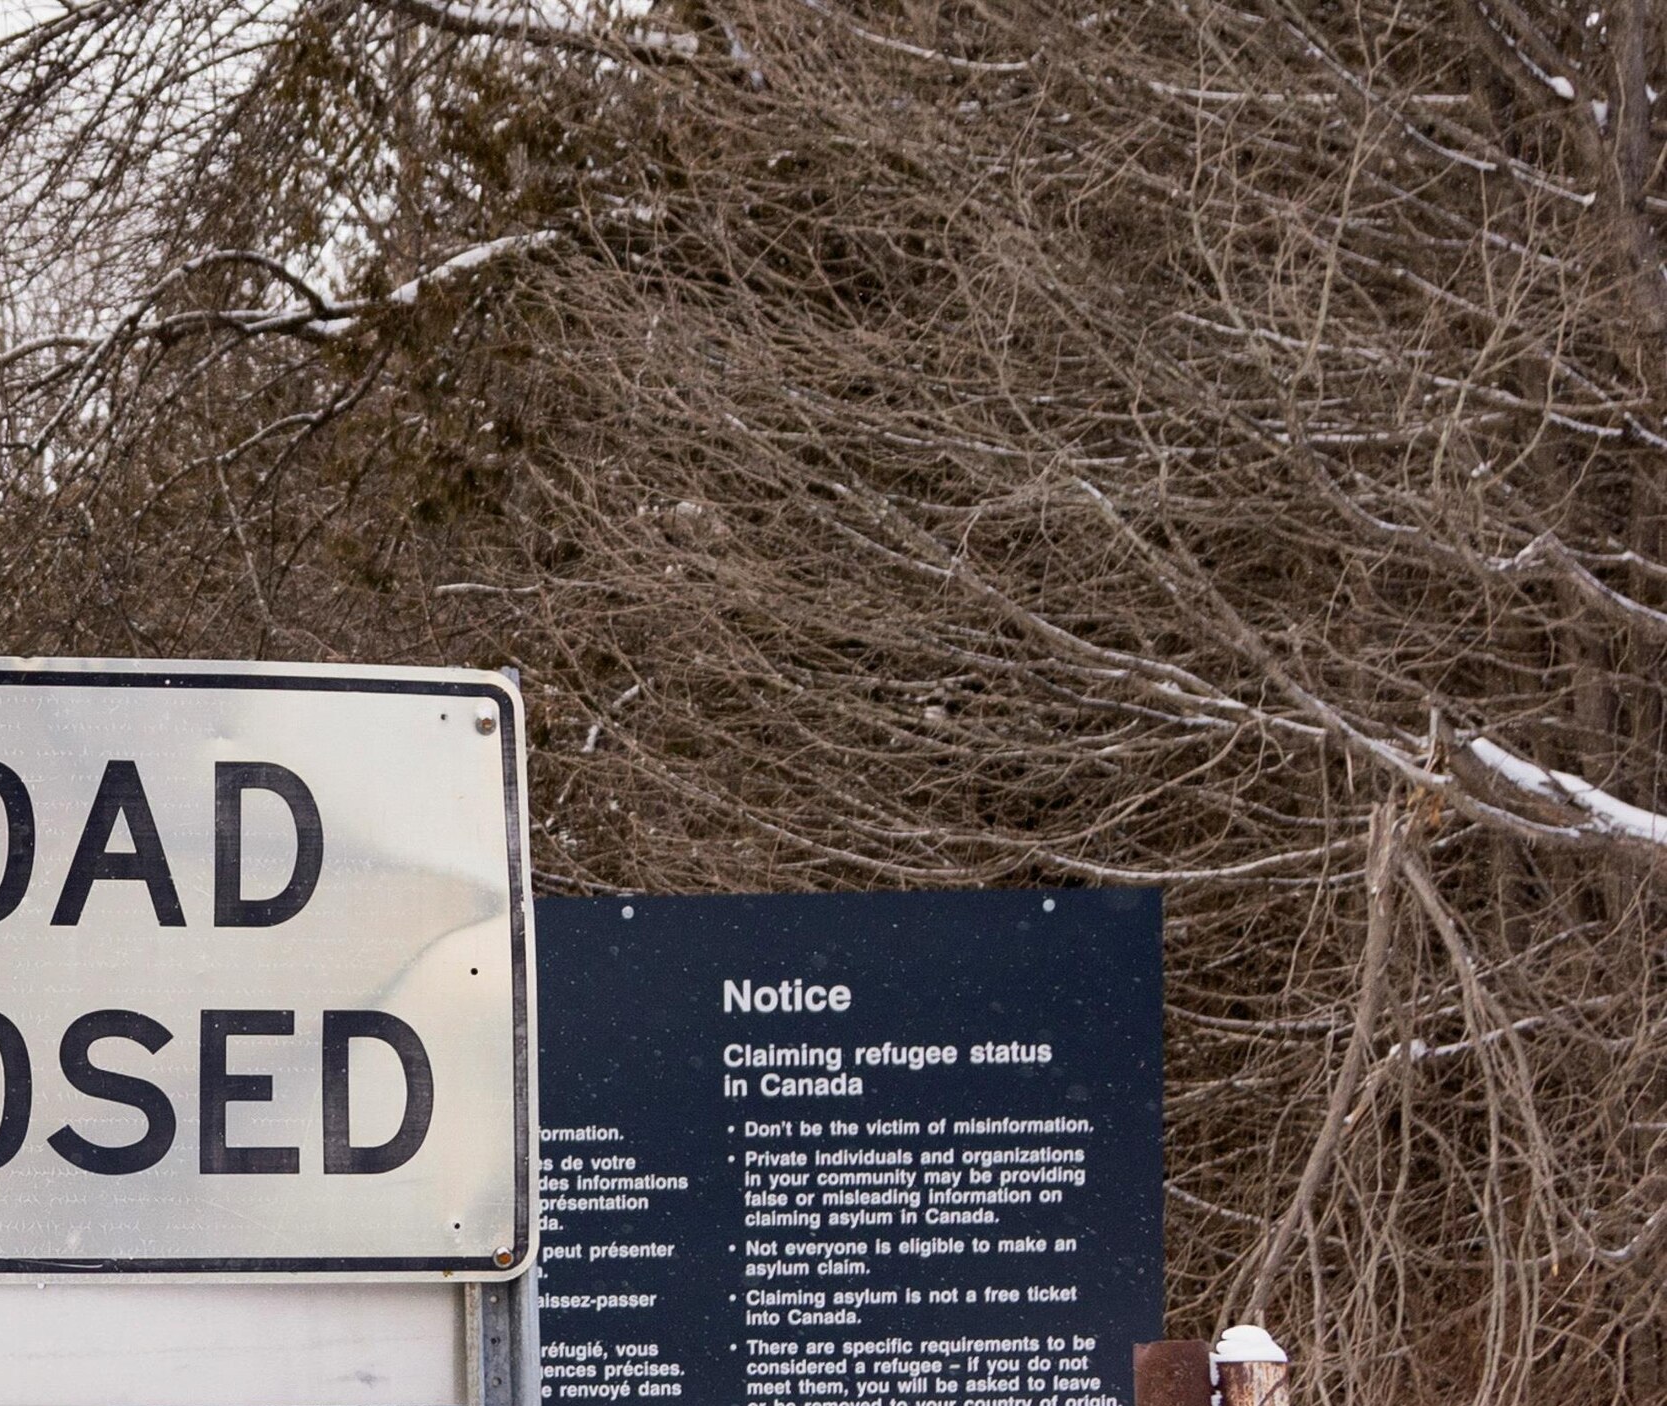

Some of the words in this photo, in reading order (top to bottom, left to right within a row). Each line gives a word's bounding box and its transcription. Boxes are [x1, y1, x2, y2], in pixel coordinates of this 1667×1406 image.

[723, 978, 852, 1013] Notice
[723, 1042, 842, 1068] Claiming
[855, 1041, 958, 1067] refugee
[969, 1040, 1053, 1064] status
[724, 1074, 748, 1097] in
[760, 1072, 863, 1097] Canada
[539, 1124, 624, 1142] ormation.
[799, 1120, 823, 1137] be
[829, 1119, 859, 1136] the
[866, 1118, 920, 1136] victim
[927, 1118, 947, 1135] of
[953, 1116, 1094, 1135] misinformation.
[560, 1155, 584, 1171] de
[590, 1155, 636, 1171] votre
[745, 1150, 808, 1167] Private
[815, 1148, 913, 1166] individuals
[920, 1148, 955, 1165] and
[961, 1146, 1085, 1168] organizations
[539, 1175, 570, 1191] des
[576, 1173, 689, 1191] informations
[744, 1170, 762, 1187] in
[768, 1173, 810, 1191] your
[816, 1168, 917, 1189] community
[923, 1171, 962, 1188] may
[969, 1167, 993, 1184] be
[999, 1166, 1086, 1188] providing
[744, 1190, 788, 1207] false
[795, 1193, 816, 1207] or
[822, 1188, 921, 1209] misleading
[928, 1187, 1032, 1205] information
[1038, 1189, 1063, 1203] on
[744, 1209, 821, 1230] claiming
[828, 1208, 893, 1229] asylum
[900, 1208, 918, 1225] in
[924, 1207, 1000, 1225] Canada.
[542, 1243, 582, 1263] peut
[589, 1241, 675, 1262] présenter
[745, 1240, 778, 1257] Not
[784, 1241, 868, 1259] everyone
[875, 1238, 892, 1255] is
[898, 1237, 965, 1258] eligible
[971, 1237, 991, 1253] to
[997, 1235, 1047, 1253] make
[1054, 1238, 1077, 1252] an
[745, 1259, 810, 1280] asylum
[817, 1258, 871, 1276] claim.
[537, 1292, 657, 1314] aissez-passer
[746, 1289, 826, 1309] Claiming
[833, 1288, 898, 1309] asylum
[905, 1287, 922, 1304] is
[929, 1287, 959, 1304] not
[965, 1289, 977, 1303] a
[983, 1286, 1020, 1303] free
[1026, 1285, 1077, 1302] ticket
[746, 1309, 781, 1326] into
[787, 1308, 862, 1326] Canada.
[540, 1340, 608, 1362] réfugié,
[615, 1343, 659, 1357] vous
[746, 1339, 799, 1356] There
[805, 1341, 835, 1355] are
[842, 1337, 913, 1358] specific
[920, 1336, 1040, 1357] requirements
[1046, 1335, 1066, 1352] to
[1072, 1334, 1096, 1351] be
[540, 1364, 597, 1381] ences
[604, 1359, 685, 1381] précises.
[746, 1358, 847, 1376] considered
[854, 1361, 866, 1374] a
[873, 1357, 943, 1376] refugee
[967, 1355, 980, 1373] if
[986, 1358, 1020, 1377] you
[1027, 1355, 1052, 1372] do
[1058, 1355, 1089, 1371] not
[559, 1379, 631, 1401] renvoyé
[638, 1380, 682, 1397] dans
[746, 1379, 792, 1395] meet
[798, 1378, 849, 1397] them,
[856, 1381, 890, 1398] you
[897, 1377, 928, 1394] will
[935, 1376, 959, 1394] be
[965, 1376, 1020, 1393] asked
[1027, 1375, 1046, 1392] to
[1053, 1374, 1101, 1391] leave
